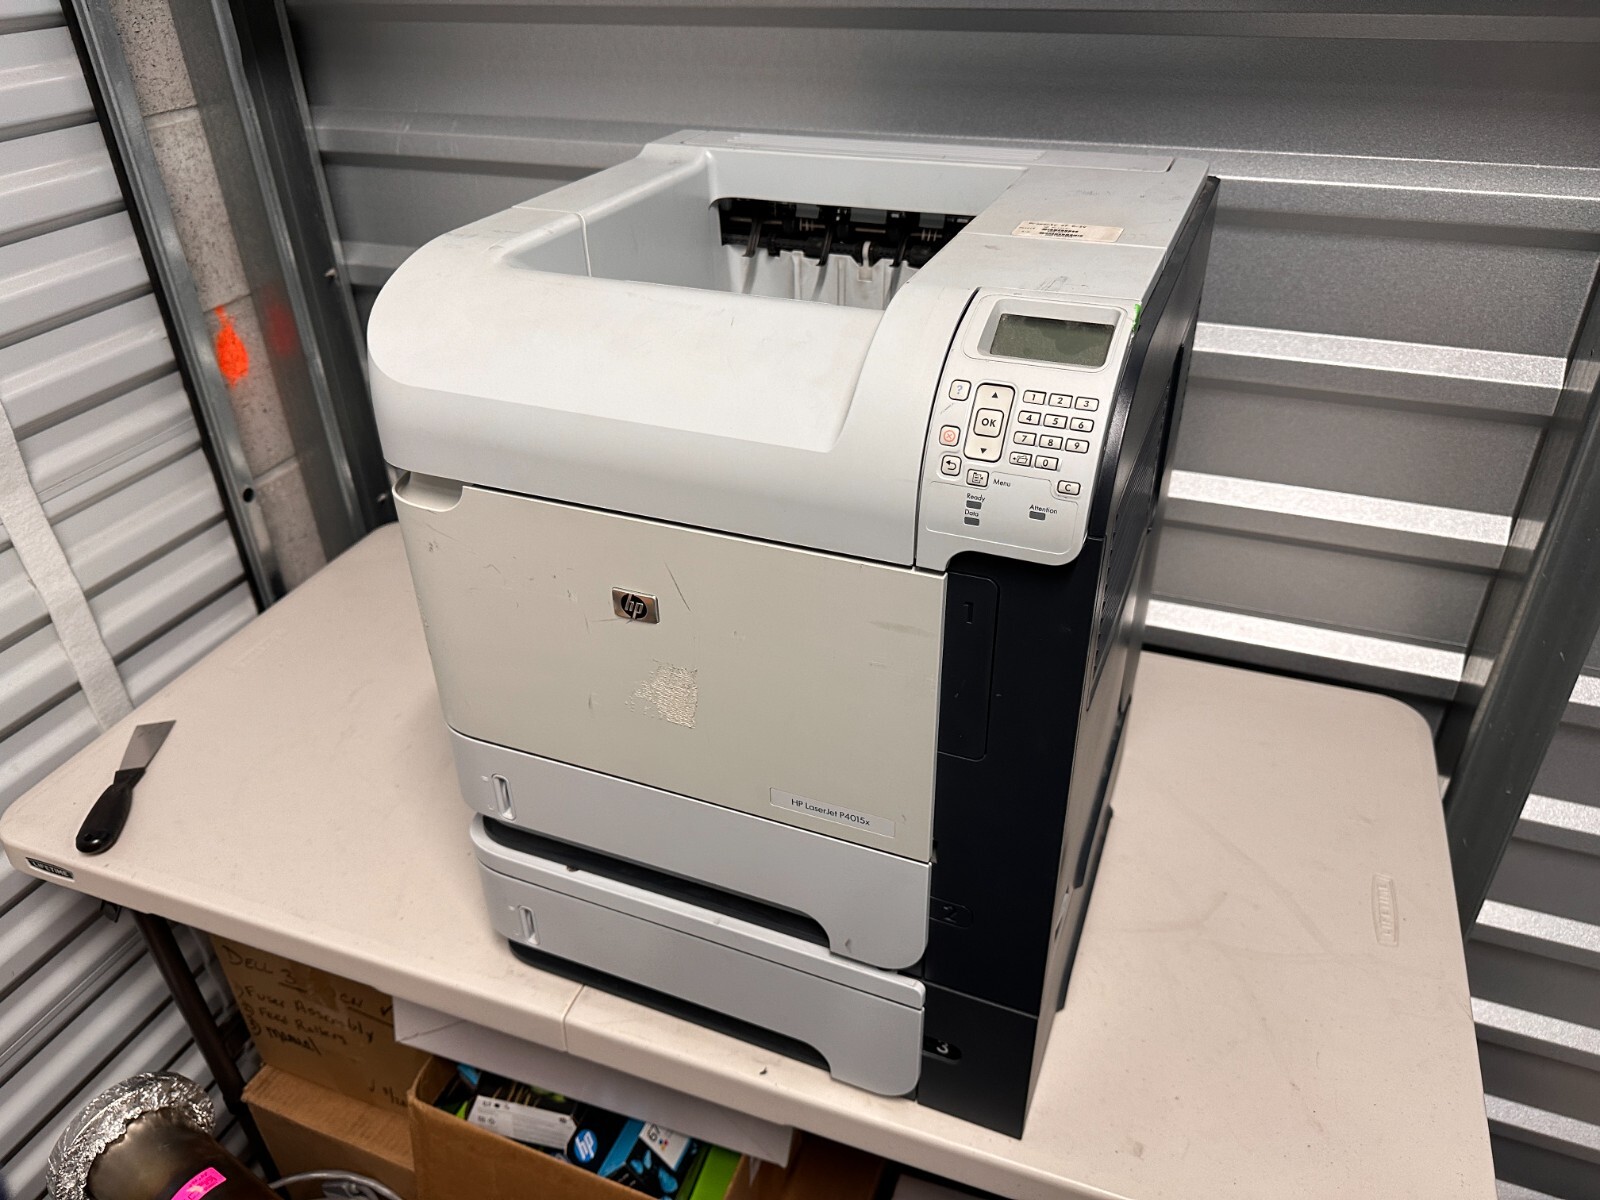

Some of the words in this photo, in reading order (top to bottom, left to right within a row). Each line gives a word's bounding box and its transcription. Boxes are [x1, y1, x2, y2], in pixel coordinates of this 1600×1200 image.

[1057, 397, 1064, 405] 2
[1083, 400, 1090, 408] 3
[1026, 414, 1033, 422] 4
[1052, 418, 1059, 426] 5
[981, 417, 997, 428] OK
[1078, 421, 1084, 429] 6
[1022, 435, 1028, 443] 7
[1047, 439, 1054, 447] 8
[1074, 442, 1080, 450] 9
[1042, 459, 1049, 467] 0
[993, 478, 1011, 488] Menu
[1064, 484, 1072, 492] C
[966, 492, 986, 503] Ready
[964, 508, 980, 517] Data
[1028, 504, 1058, 514] Attention
[624, 593, 644, 620] hp
[791, 798, 803, 807] HP
[805, 802, 838, 817] LaserJet
[839, 811, 871, 826] P4015x
[935, 1039, 950, 1054] 3
[574, 1130, 596, 1162] hp
